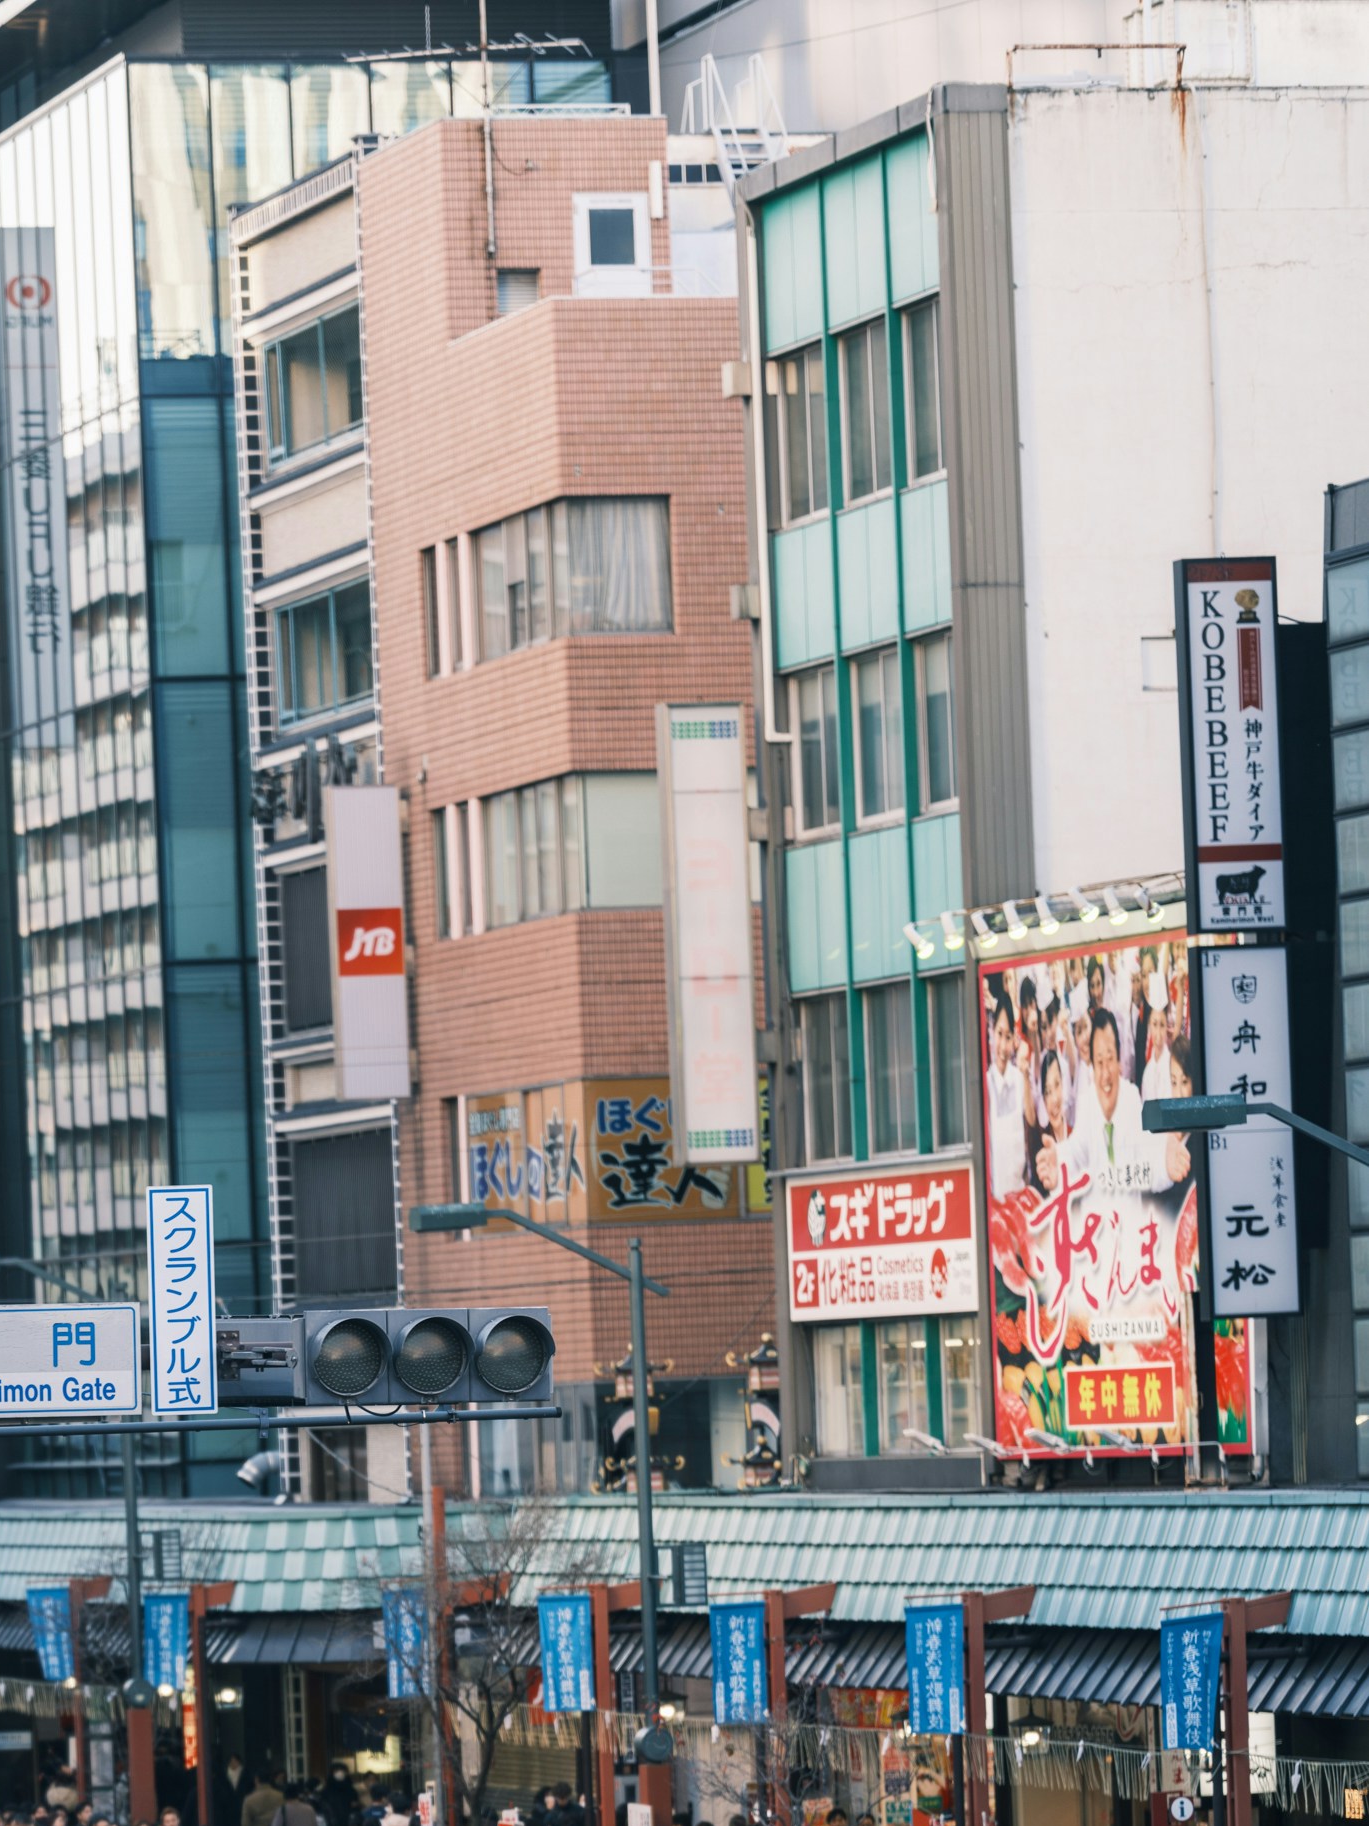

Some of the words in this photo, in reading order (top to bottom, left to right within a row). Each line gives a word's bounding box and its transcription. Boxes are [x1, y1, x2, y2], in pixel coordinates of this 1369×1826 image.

[1244, 718, 1265, 842] 神戸牛ダイア
[343, 926, 397, 963] JTB
[1203, 951, 1221, 968] 1F
[470, 1107, 586, 1205] ほぐしの達人
[1210, 1132, 1228, 1151] B1
[598, 1132, 725, 1210] 達人
[876, 1252, 925, 1276] Cosmetics
[1221, 1203, 1277, 1293] 元松
[163, 1196, 202, 1407] スクランブル式
[795, 1262, 816, 1304] 2F
[821, 1256, 876, 1306] 化粧品
[1089, 1319, 1166, 1340] SUSHIZANMAI
[61, 1376, 117, 1403] Gate
[1078, 1372, 1163, 1420] 年中無休
[728, 1615, 747, 1721] 新春浅草歌舞伎
[1181, 1629, 1202, 1747] 新春浅草歌舞伎
